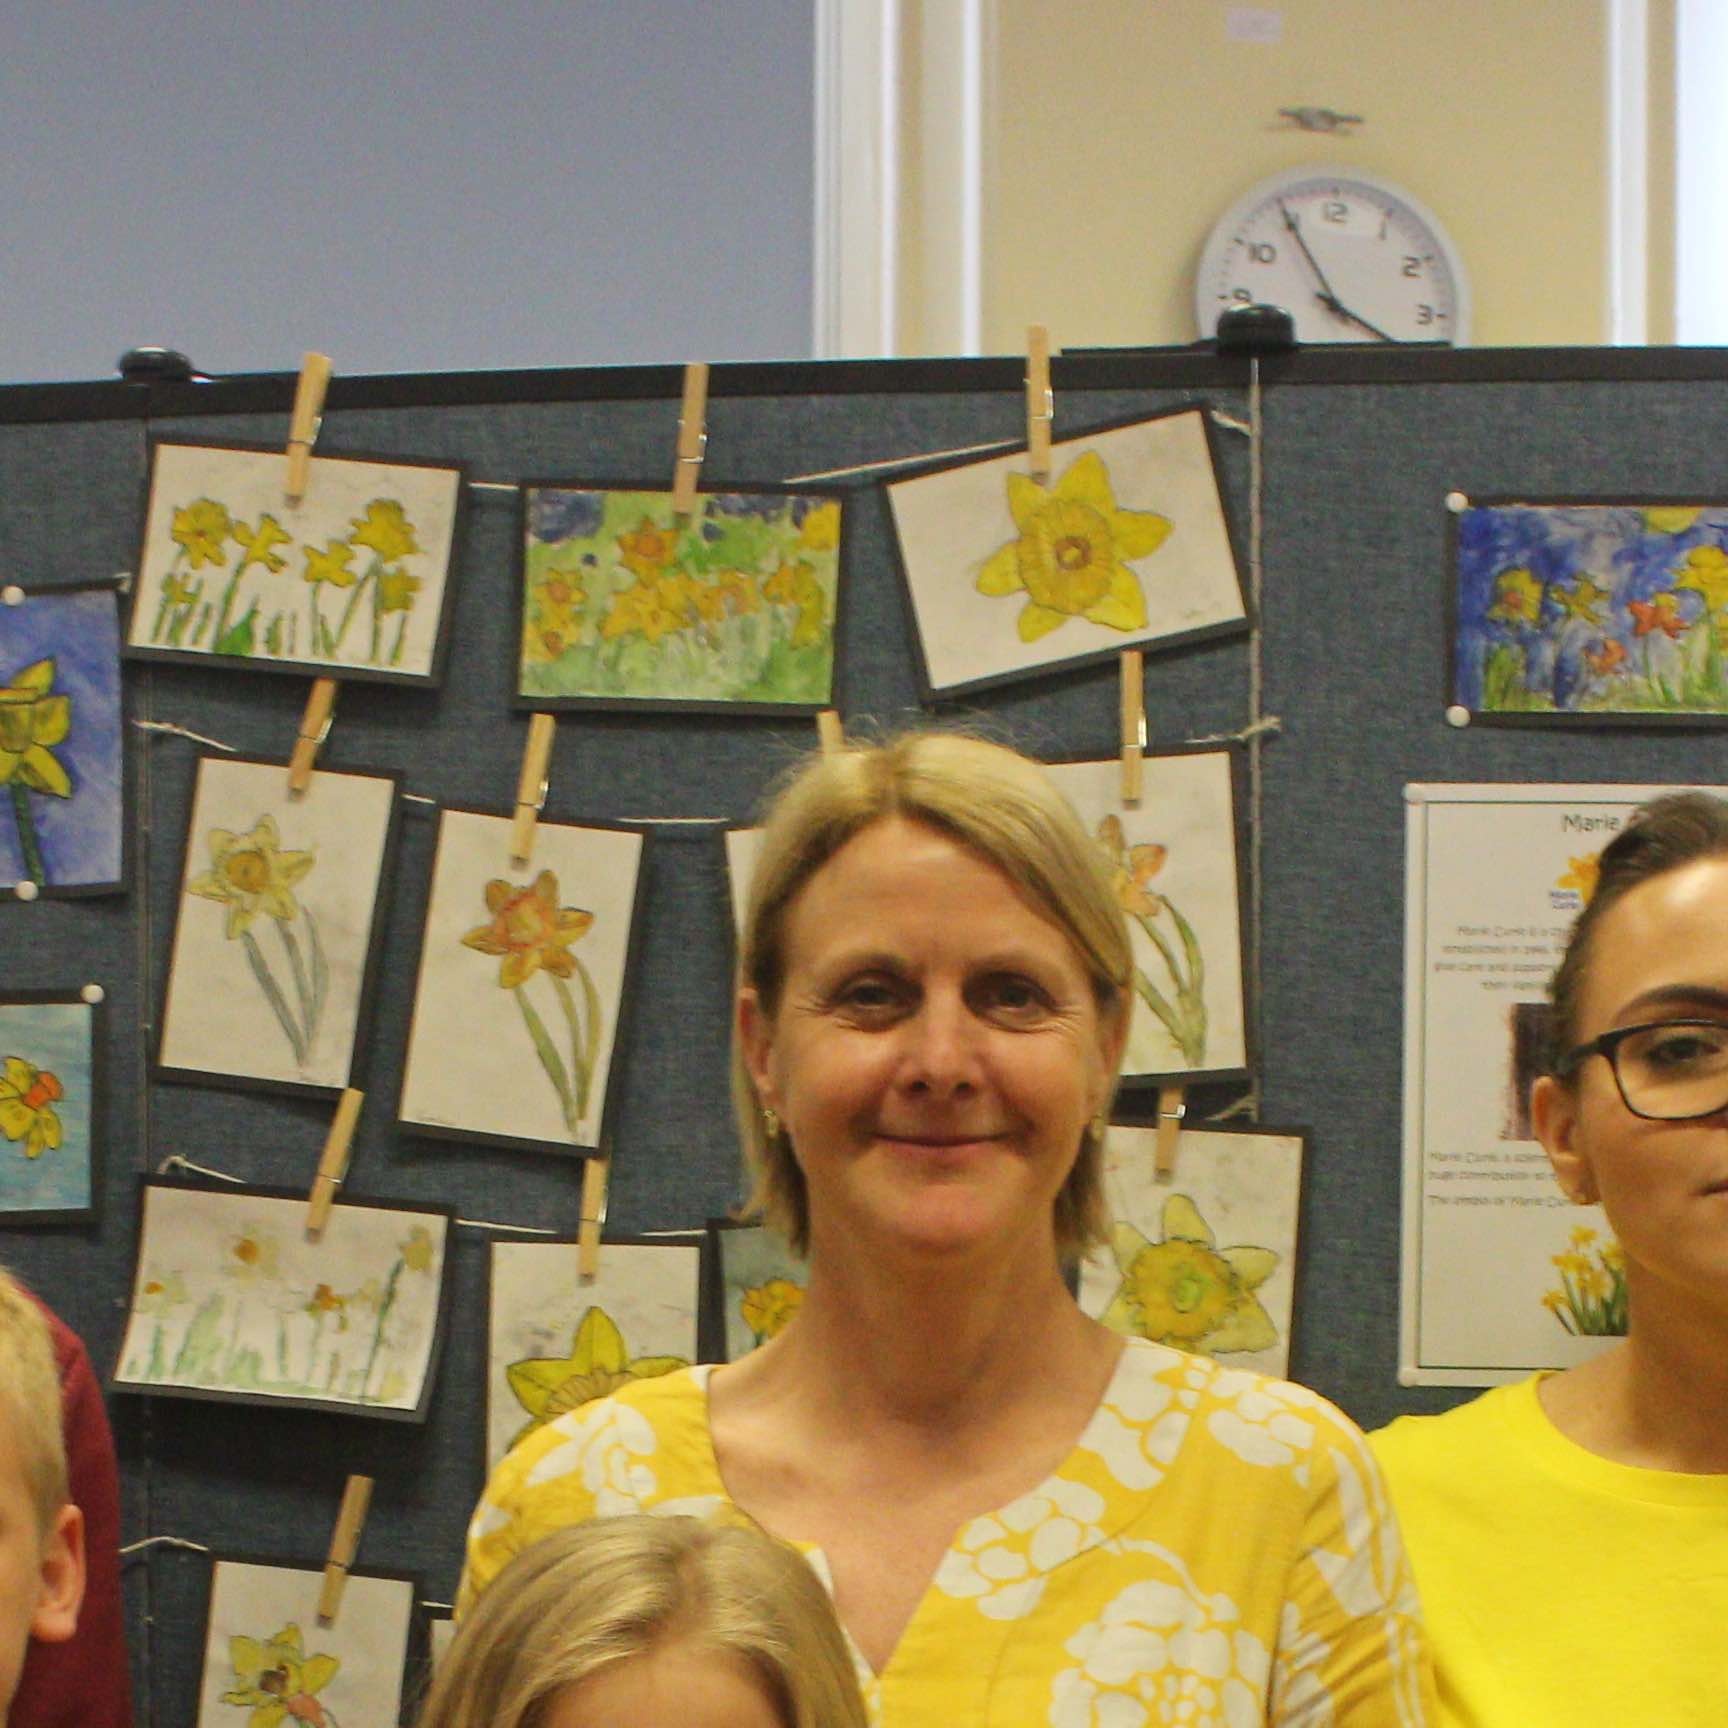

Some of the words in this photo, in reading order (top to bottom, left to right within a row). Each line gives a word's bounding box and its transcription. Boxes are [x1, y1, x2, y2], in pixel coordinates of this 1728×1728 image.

[1322, 202, 1348, 223] 12
[1248, 243, 1277, 264] 10
[1403, 256, 1421, 277] 2
[1417, 304, 1433, 324] 3
[1562, 814, 1620, 833] Marie
